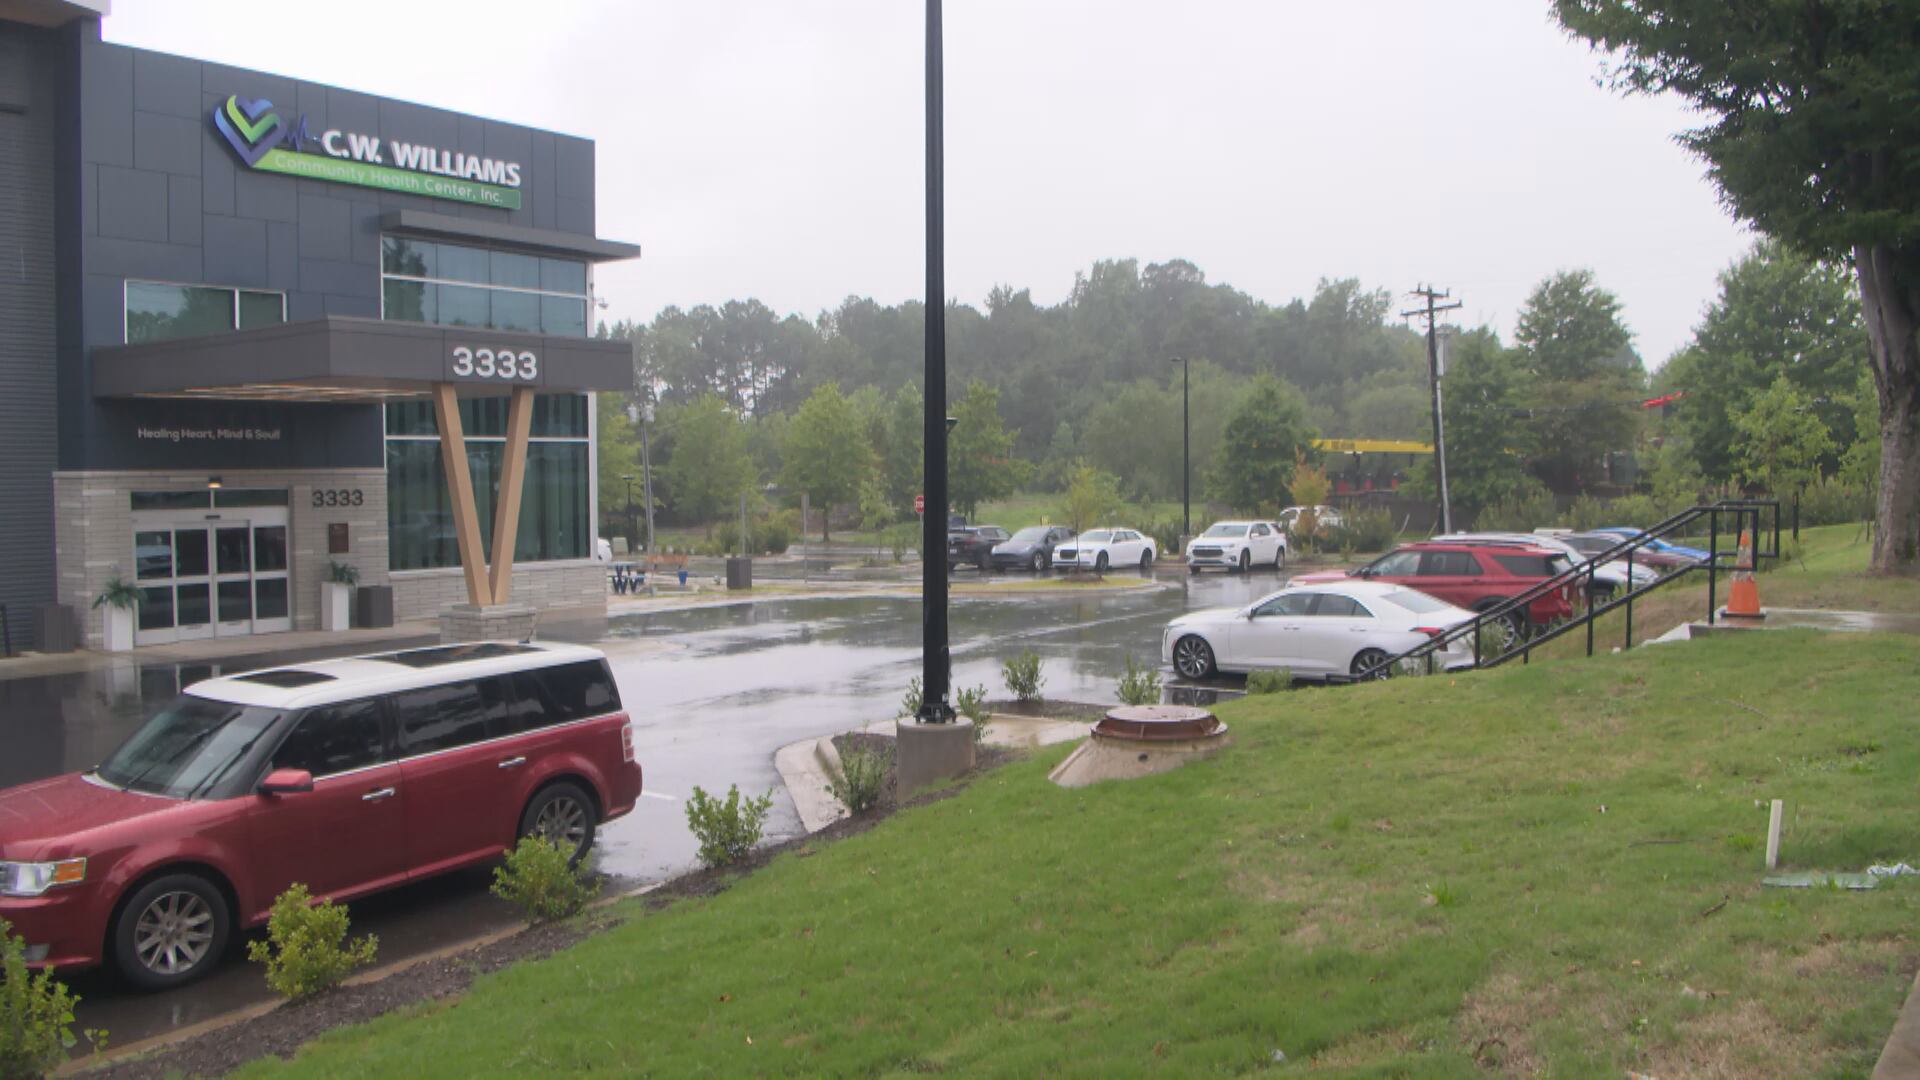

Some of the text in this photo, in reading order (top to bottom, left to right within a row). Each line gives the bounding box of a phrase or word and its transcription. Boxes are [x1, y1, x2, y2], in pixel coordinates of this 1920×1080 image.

[322, 129, 521, 188] C.W. WILLIAMS
[274, 154, 503, 202] Community Health Center, Inc.
[453, 347, 538, 380] 3333
[138, 427, 180, 442] Healing
[181, 428, 216, 440] Heart,
[217, 428, 243, 440] Mind
[312, 488, 364, 507] 3333
